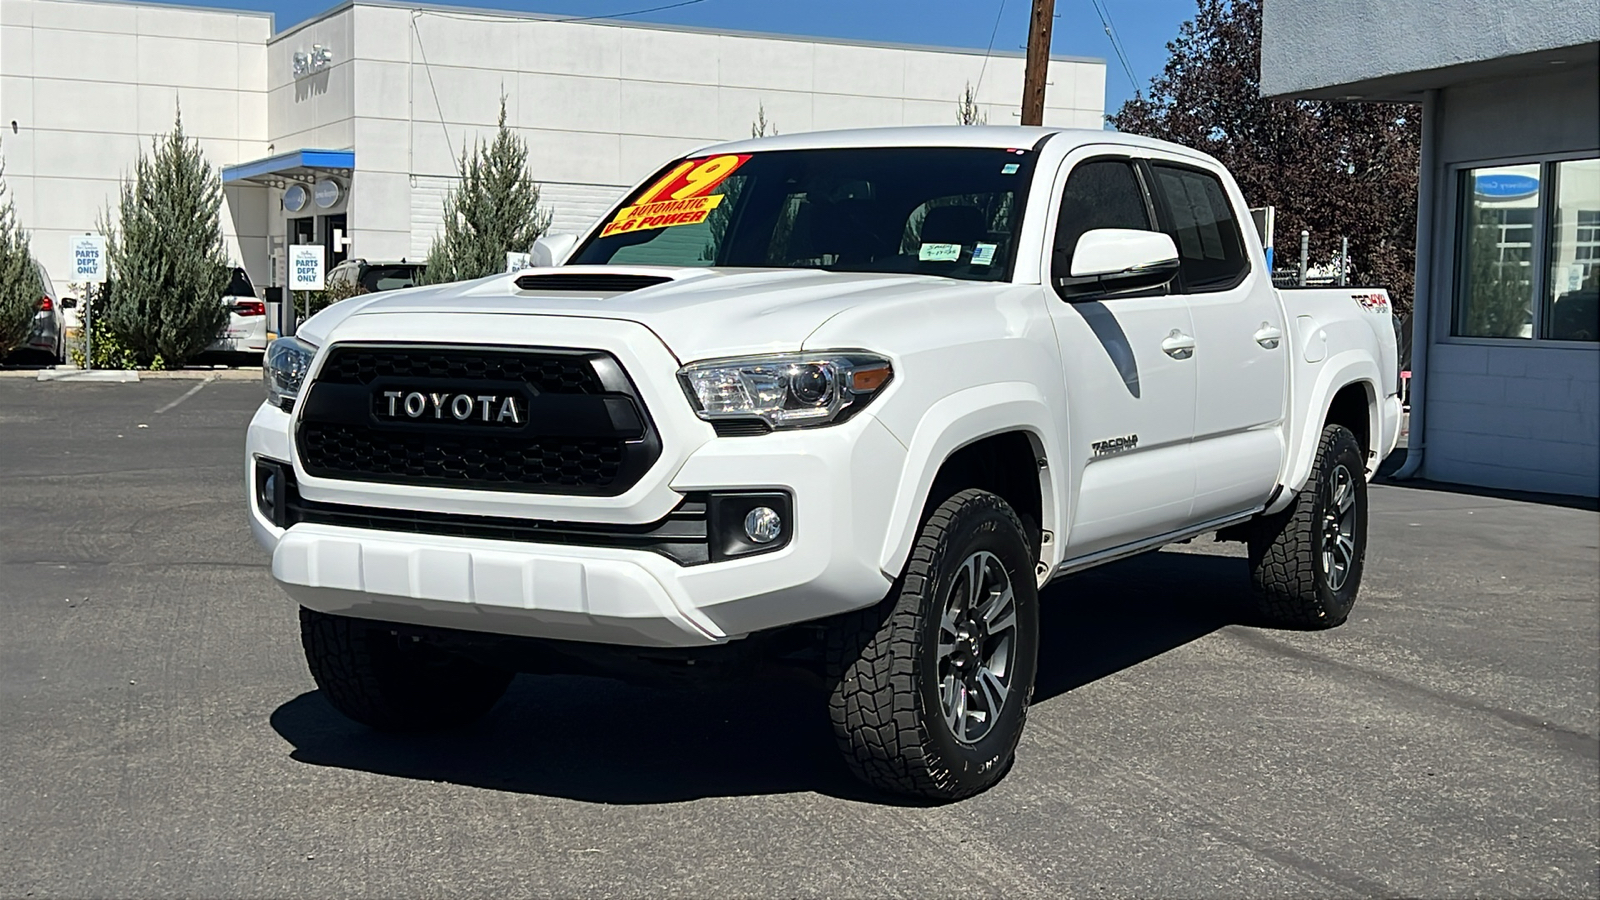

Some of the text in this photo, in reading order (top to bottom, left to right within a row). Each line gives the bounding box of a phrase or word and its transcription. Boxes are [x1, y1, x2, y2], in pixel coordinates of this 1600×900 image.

[635, 155, 739, 205] 19
[627, 197, 709, 218] AUTOMATIC
[603, 210, 707, 235] V-6 POWER
[75, 250, 100, 258] PARTS
[77, 266, 98, 274] ONLY
[295, 259, 318, 267] PARTS
[297, 274, 317, 282] ONLY
[384, 391, 519, 423] TOYOTA
[1091, 434, 1138, 450] TACOMA
